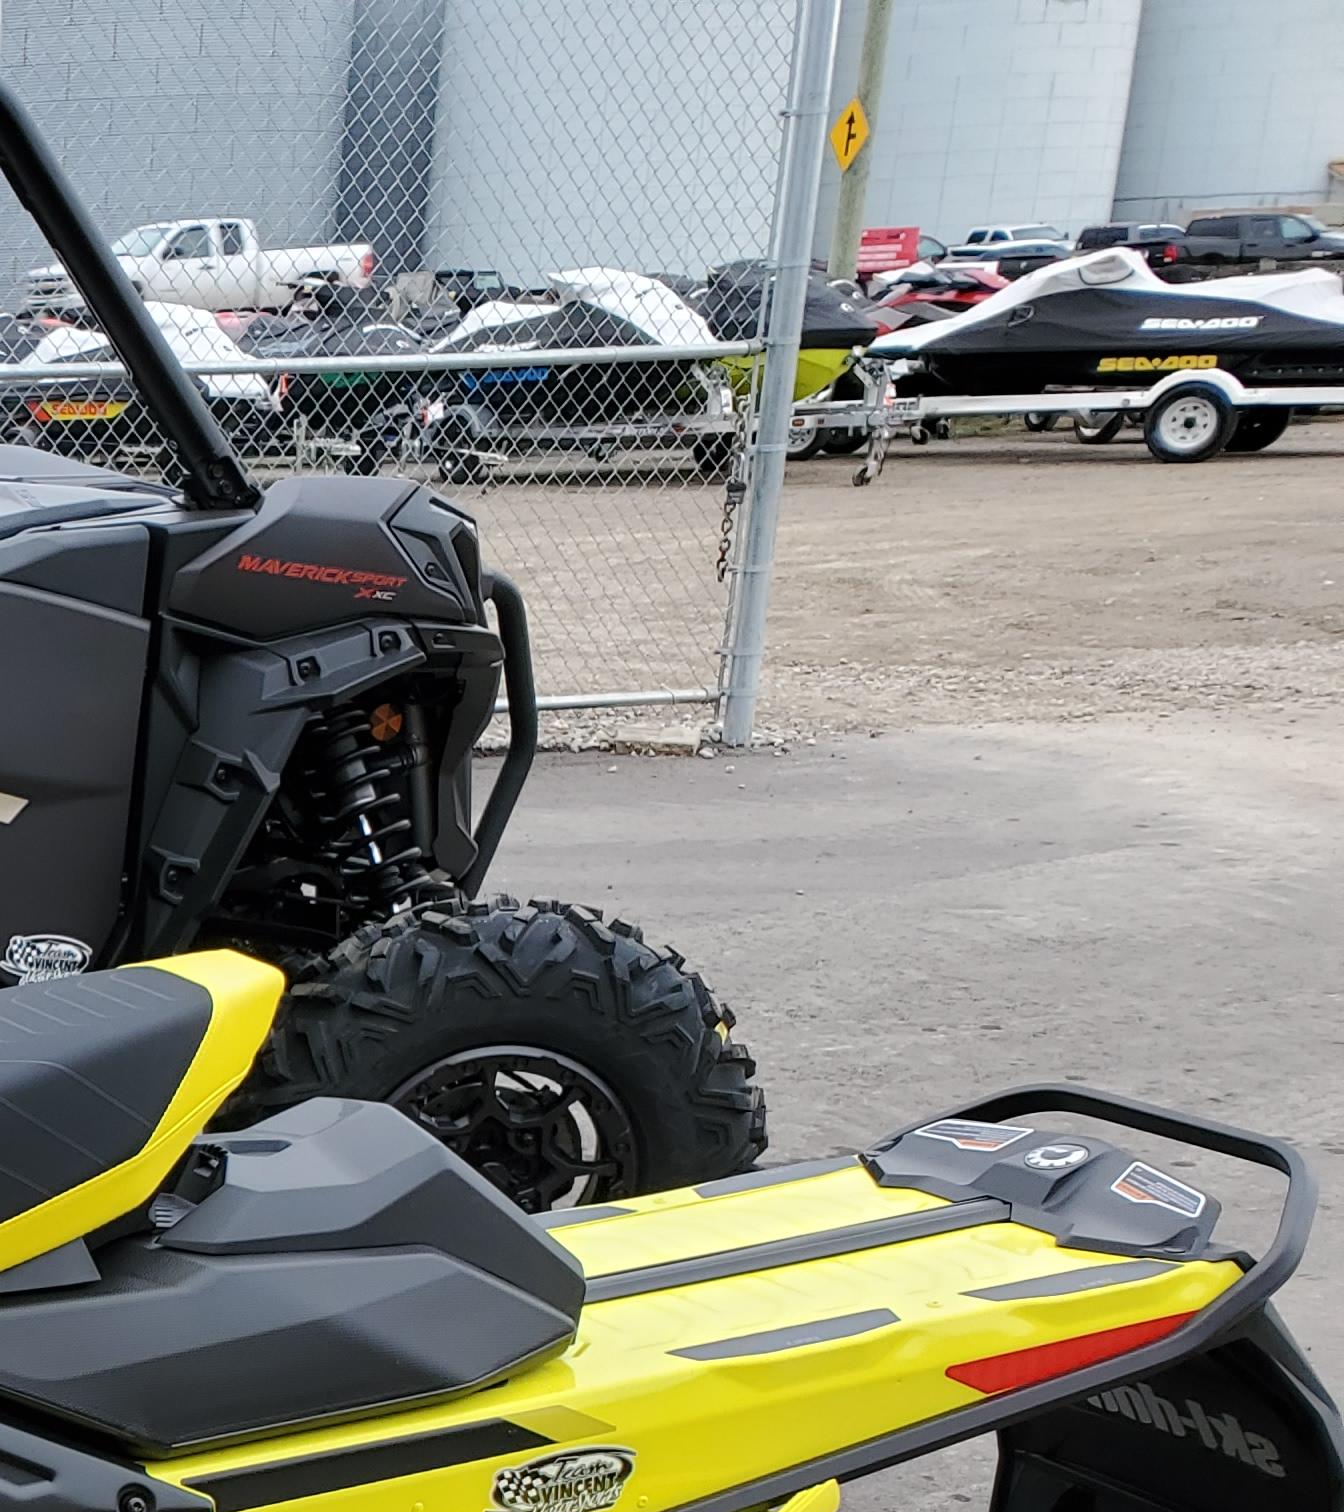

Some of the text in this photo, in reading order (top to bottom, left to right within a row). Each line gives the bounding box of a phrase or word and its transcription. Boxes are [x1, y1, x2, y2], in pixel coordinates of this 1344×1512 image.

[237, 554, 351, 584] MAVERICK
[552, 1456, 610, 1483] Team
[540, 1471, 618, 1503] VINCENT
